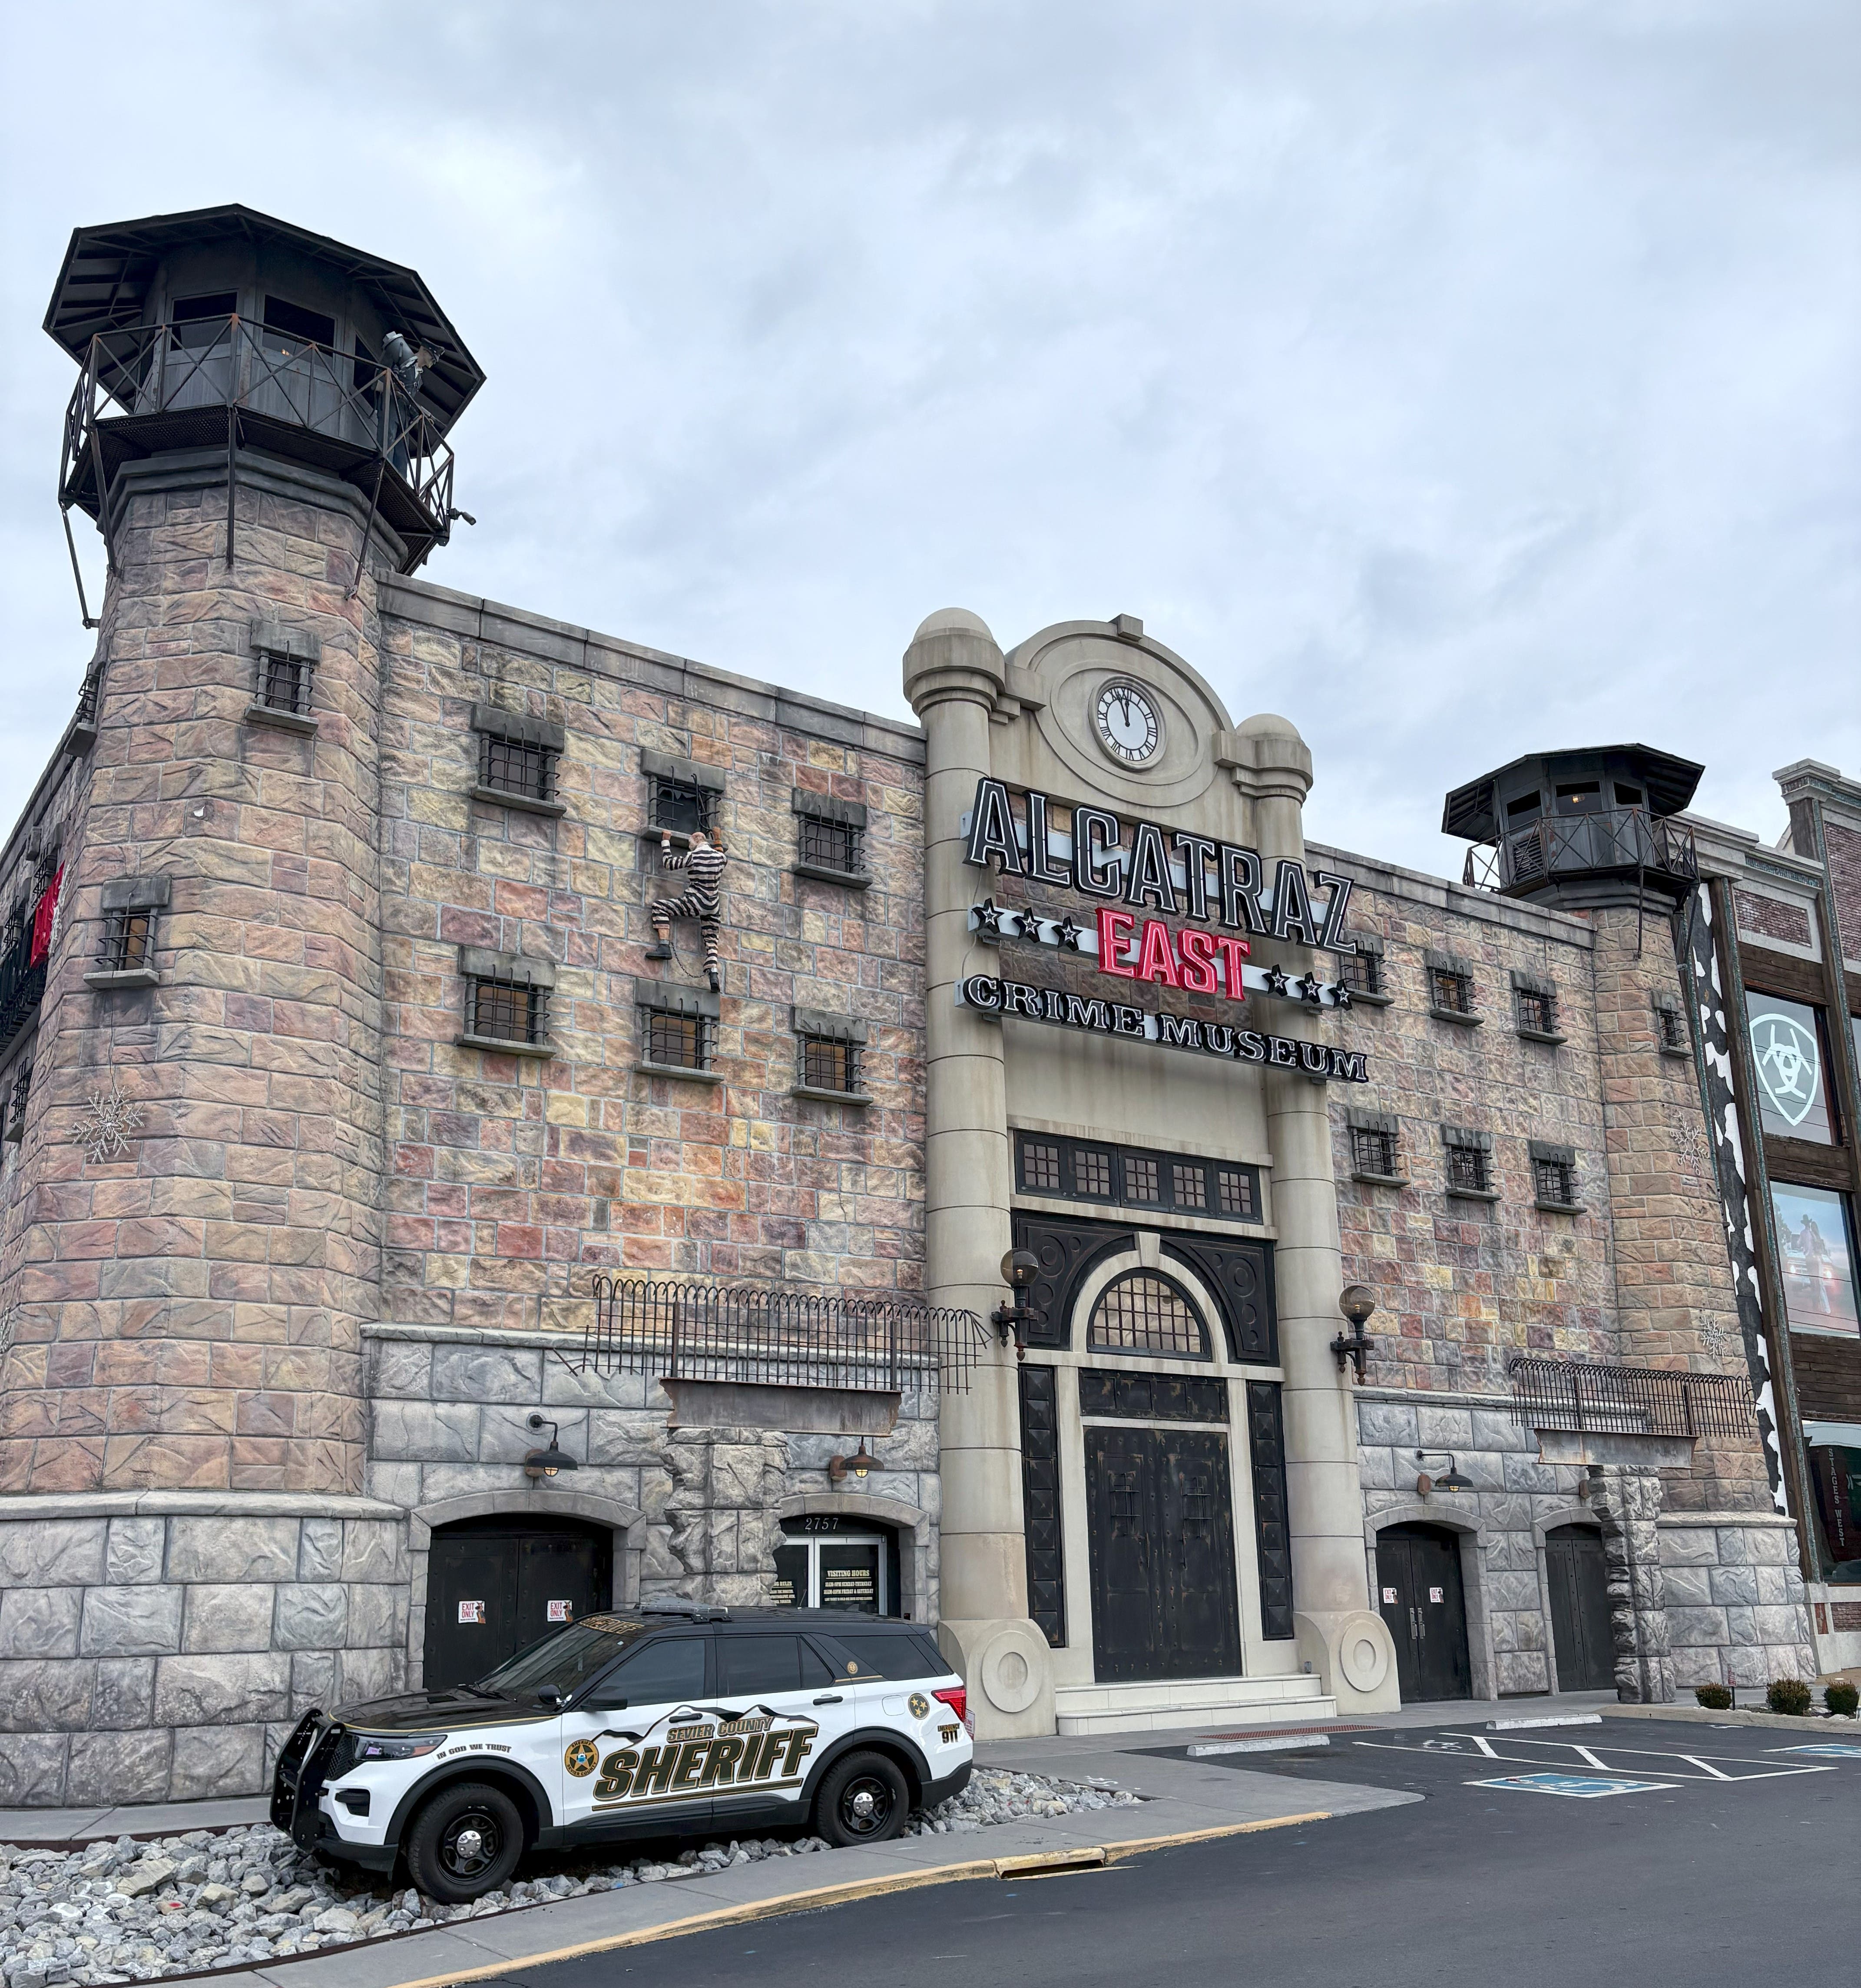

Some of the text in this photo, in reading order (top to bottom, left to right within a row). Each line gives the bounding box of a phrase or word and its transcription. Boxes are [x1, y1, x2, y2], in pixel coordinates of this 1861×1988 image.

[962, 777, 1358, 955] ALCATRAZ
[1095, 907, 1251, 1001] EAST
[963, 974, 1369, 1083] CRIME MUSEUM
[1828, 1448, 1845, 1546] STAGES WEST
[805, 1518, 838, 1530] 2757
[667, 1716, 775, 1743] SEVIER COUNTY
[937, 1723, 960, 1732] EMERGENCY
[942, 1730, 958, 1744] 911
[436, 1751, 447, 1760] IN
[448, 1746, 467, 1755] GOD
[485, 1743, 512, 1753] TRUST
[593, 1726, 819, 1801] SHERIFF
[566, 1762, 596, 1776] SEVIER COUNTY
